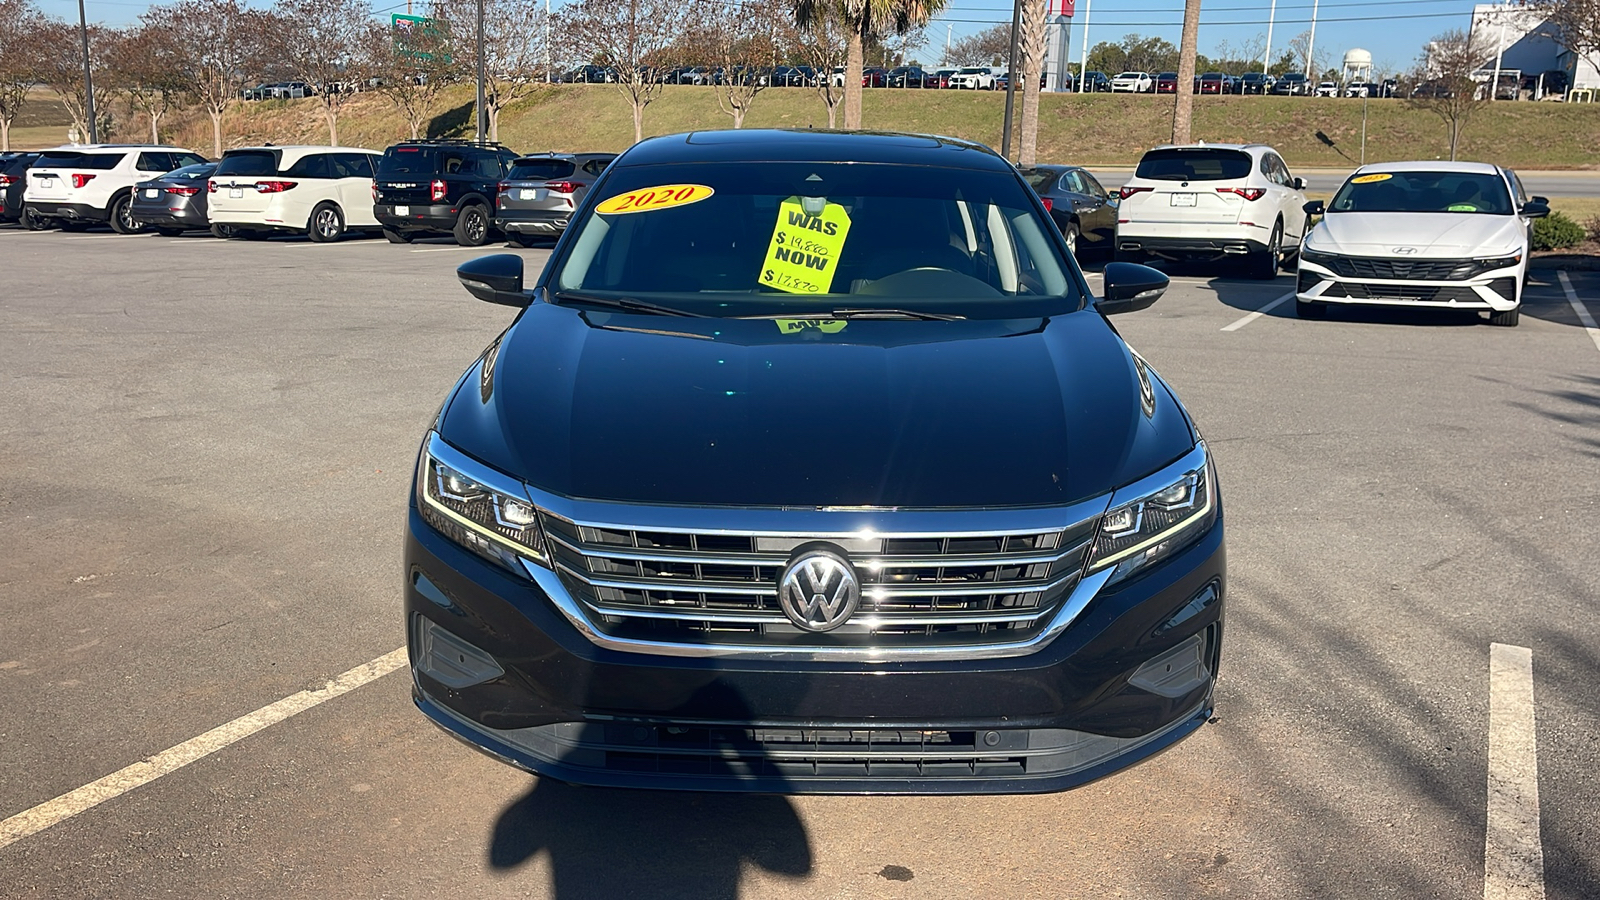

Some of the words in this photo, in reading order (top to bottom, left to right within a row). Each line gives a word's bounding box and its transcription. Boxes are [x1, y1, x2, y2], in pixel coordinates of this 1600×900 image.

[613, 187, 695, 212] 2020
[788, 210, 839, 236] WAS
[774, 246, 829, 271] NOW
